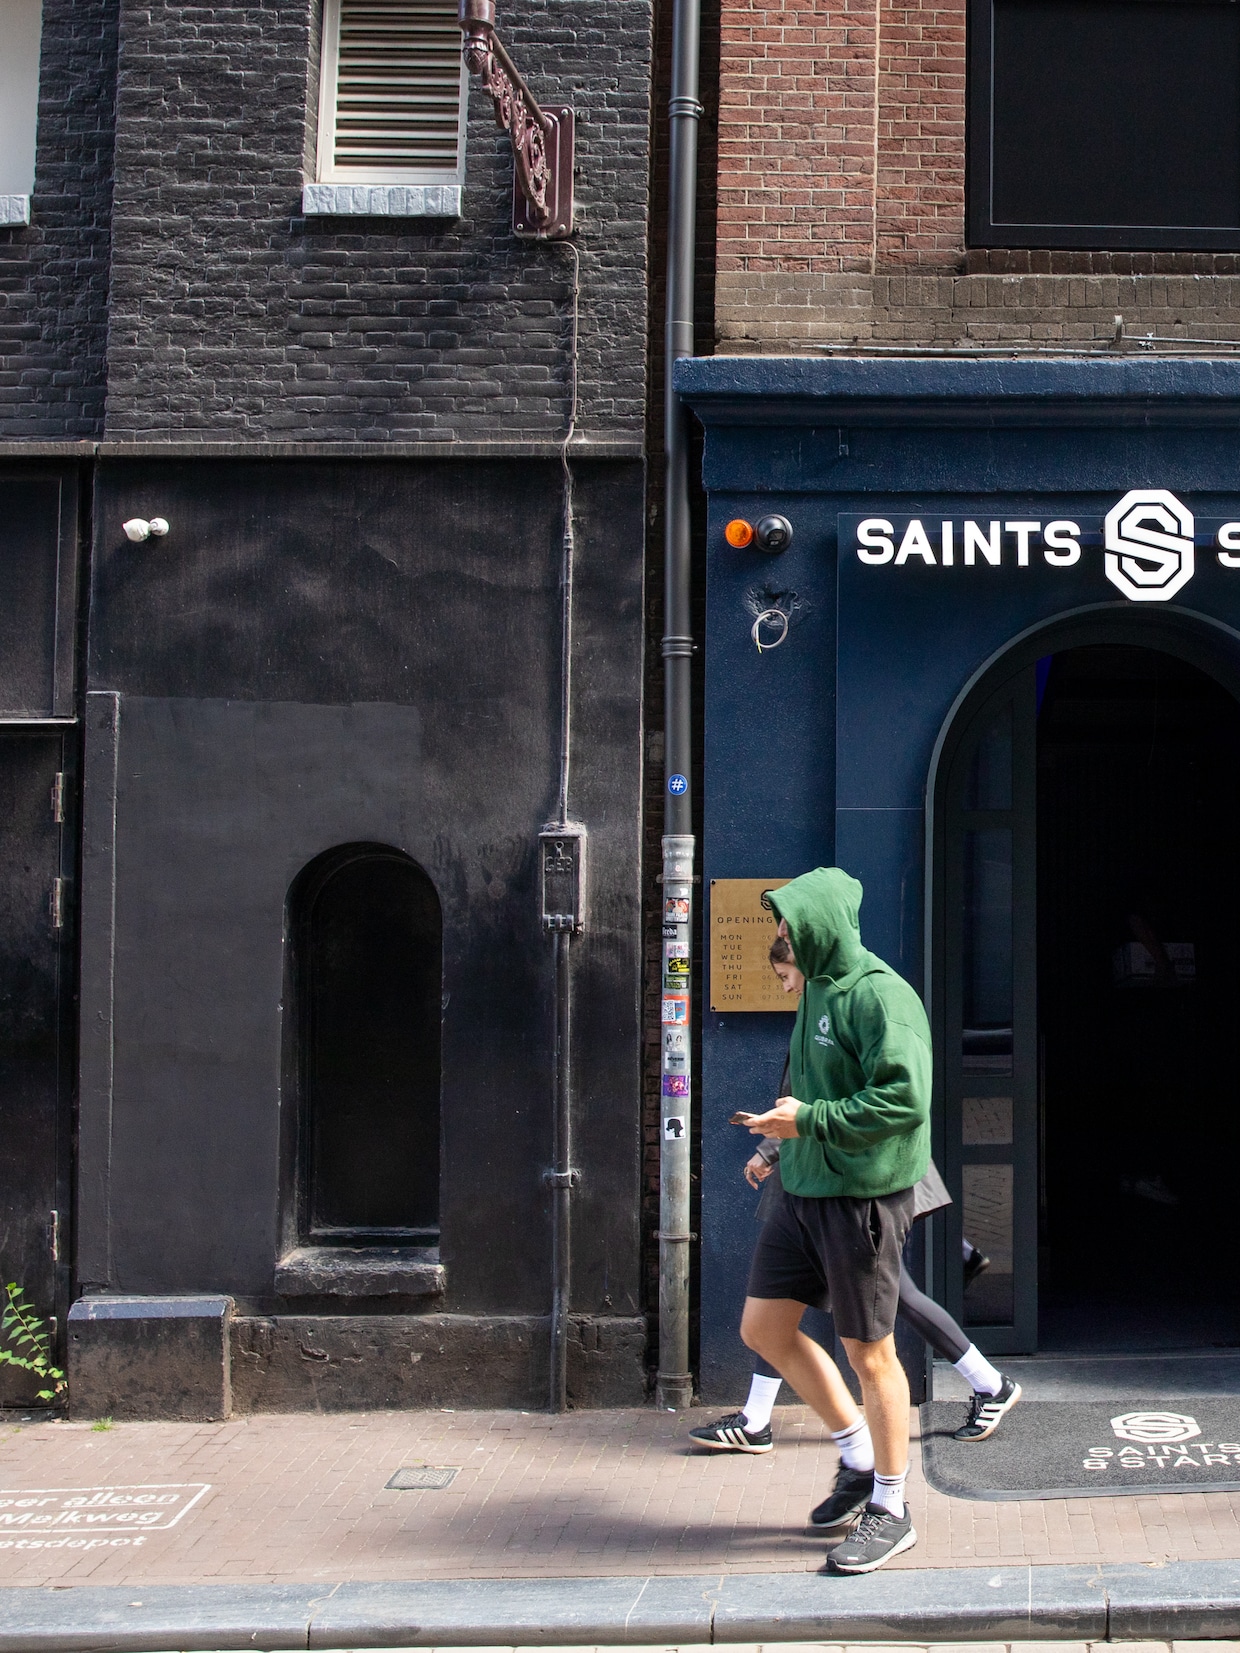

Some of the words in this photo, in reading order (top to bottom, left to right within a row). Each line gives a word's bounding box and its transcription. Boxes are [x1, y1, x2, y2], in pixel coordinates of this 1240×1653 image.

[856, 518, 1082, 568] SAINTS
[717, 916, 773, 924] OPENING
[1082, 1457, 1110, 1470] &
[63, 1491, 180, 1507] alleen
[0, 1510, 164, 1525] Melkweg
